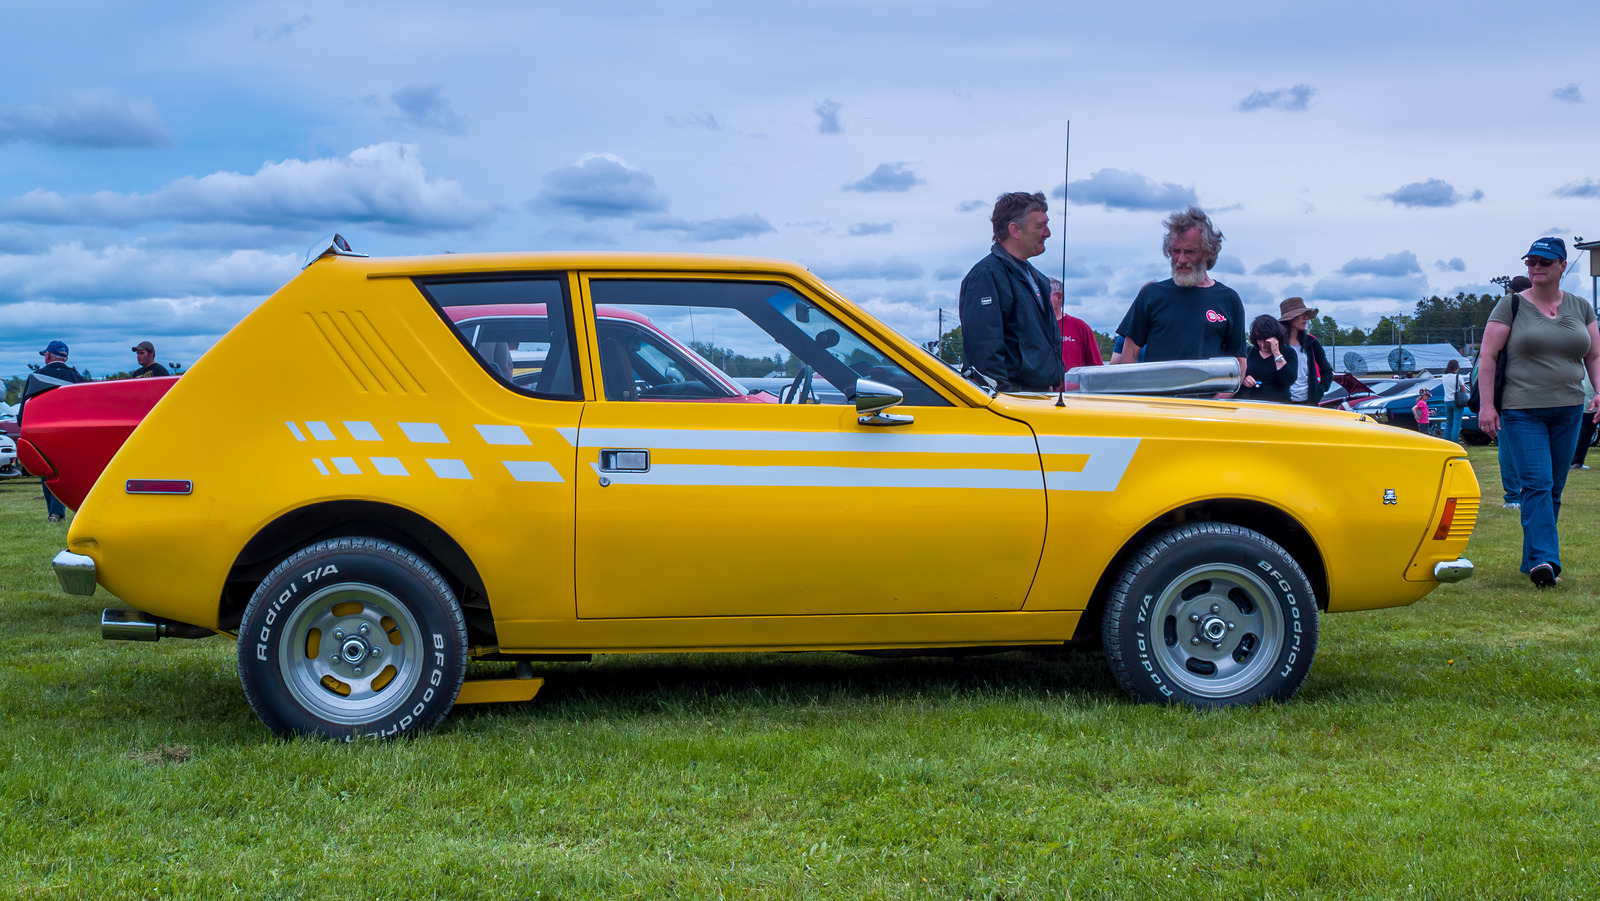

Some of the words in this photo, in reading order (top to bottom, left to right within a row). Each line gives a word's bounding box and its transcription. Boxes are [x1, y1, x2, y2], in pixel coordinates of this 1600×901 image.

[256, 582, 298, 661] Radial
[302, 564, 338, 583] T/A
[1137, 594, 1154, 625] T/A
[1257, 560, 1303, 678] BFGoodrich
[1136, 632, 1174, 697] Radial
